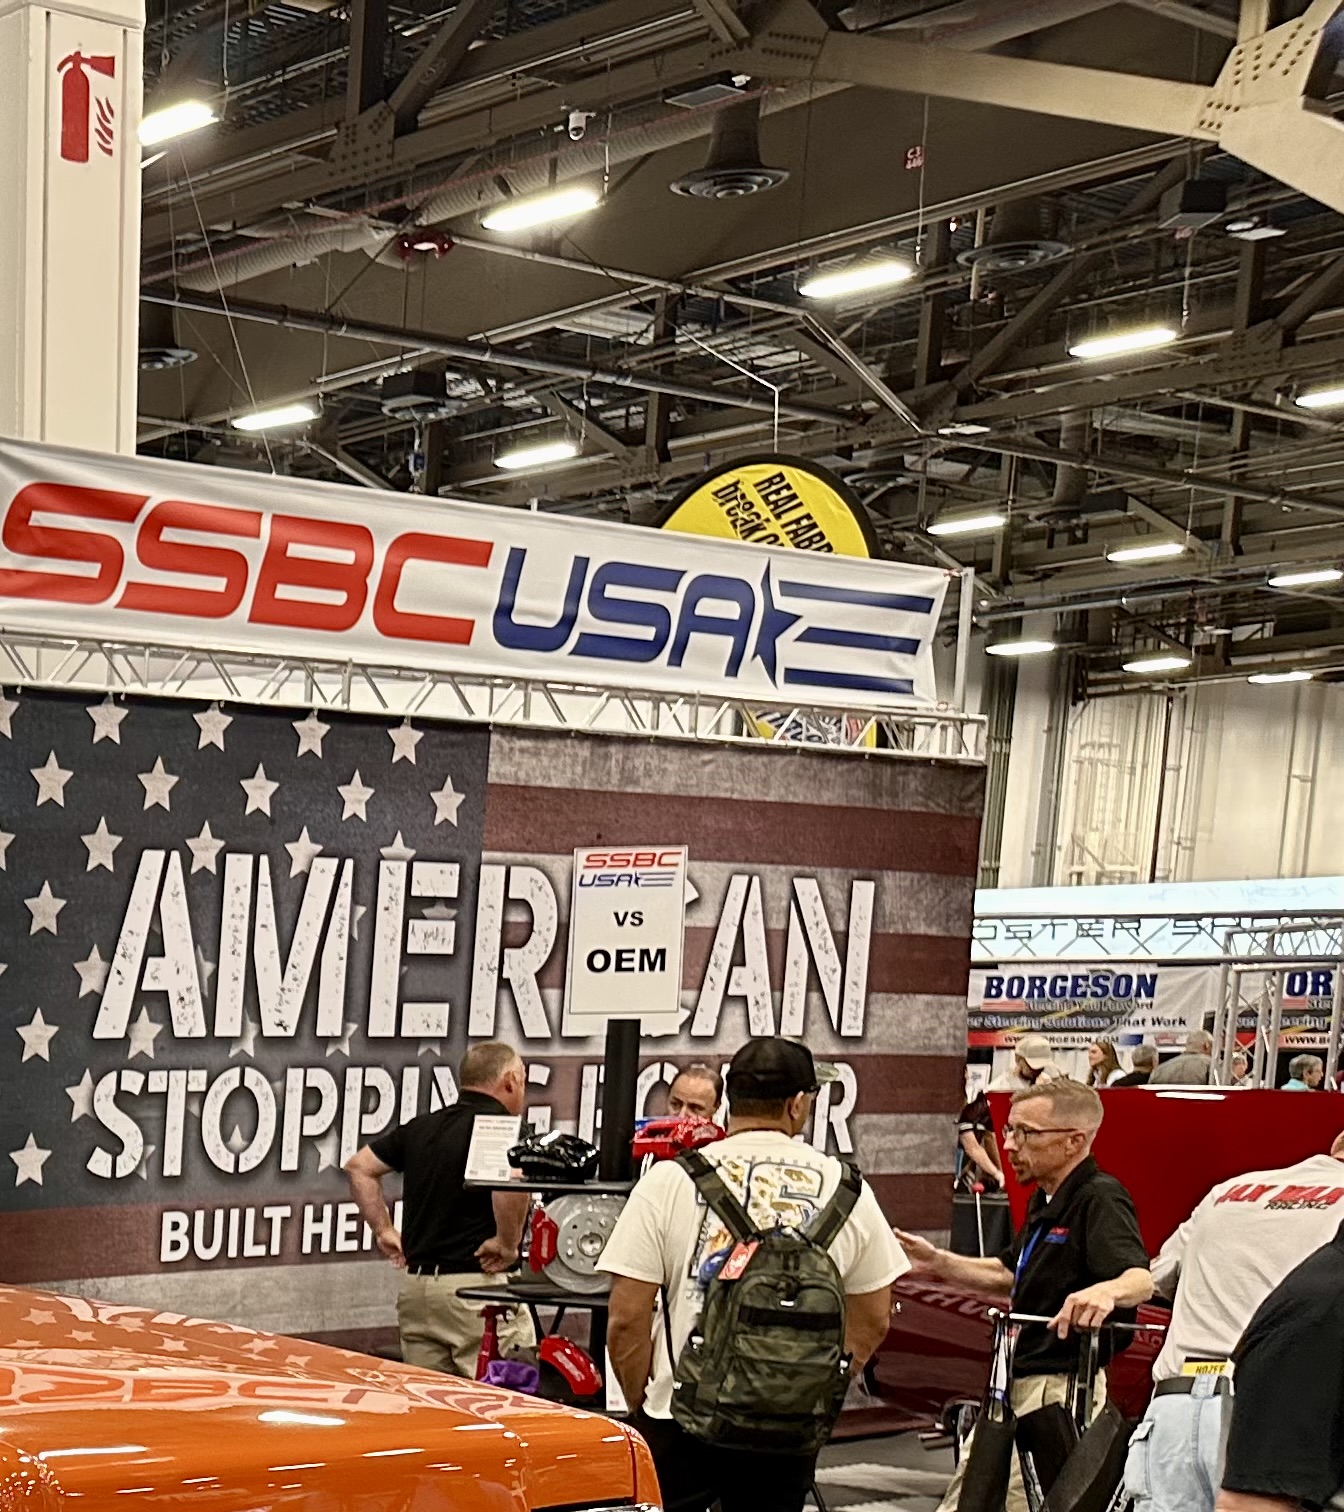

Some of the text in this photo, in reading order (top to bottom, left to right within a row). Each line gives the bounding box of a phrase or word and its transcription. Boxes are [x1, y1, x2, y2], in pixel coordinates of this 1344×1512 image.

[754, 471, 805, 521] REAL
[583, 851, 682, 869] SSBC
[578, 873, 633, 887] USA
[92, 849, 875, 1039] AMERAN
[586, 948, 667, 973] OEM
[983, 973, 1158, 999] BORGESON
[1151, 1014, 1187, 1027] Work
[160, 1206, 291, 1262] BUILT
